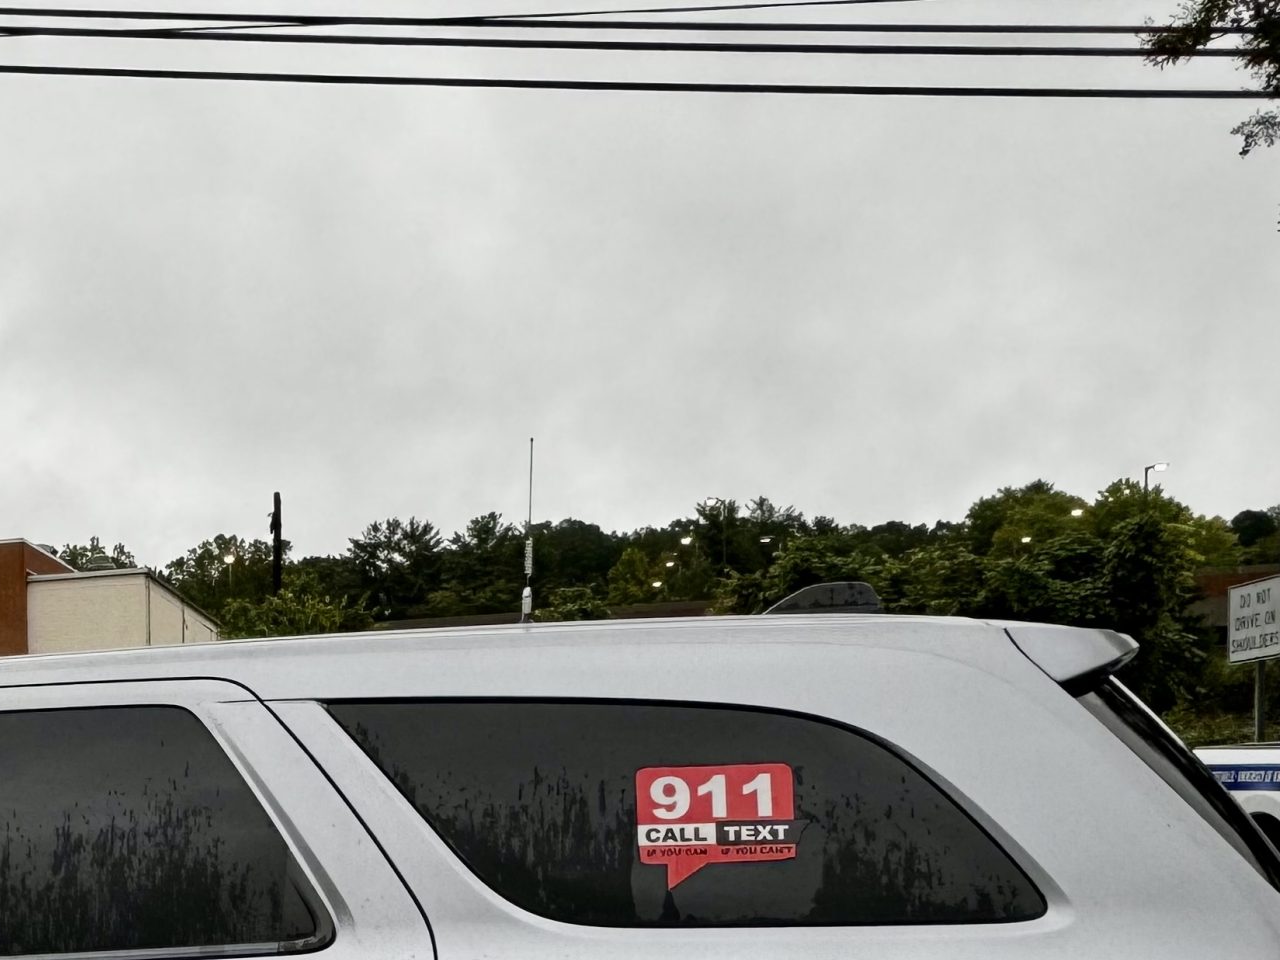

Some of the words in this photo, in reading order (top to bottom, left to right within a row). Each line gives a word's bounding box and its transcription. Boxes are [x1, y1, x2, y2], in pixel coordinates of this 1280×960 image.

[1240, 593, 1251, 609] DO
[1256, 588, 1271, 604] NOT
[1234, 613, 1261, 631] DRIVE
[1264, 610, 1276, 625] ON
[649, 772, 773, 820] 911
[645, 826, 708, 843] CALL
[724, 825, 789, 841] TEXT
